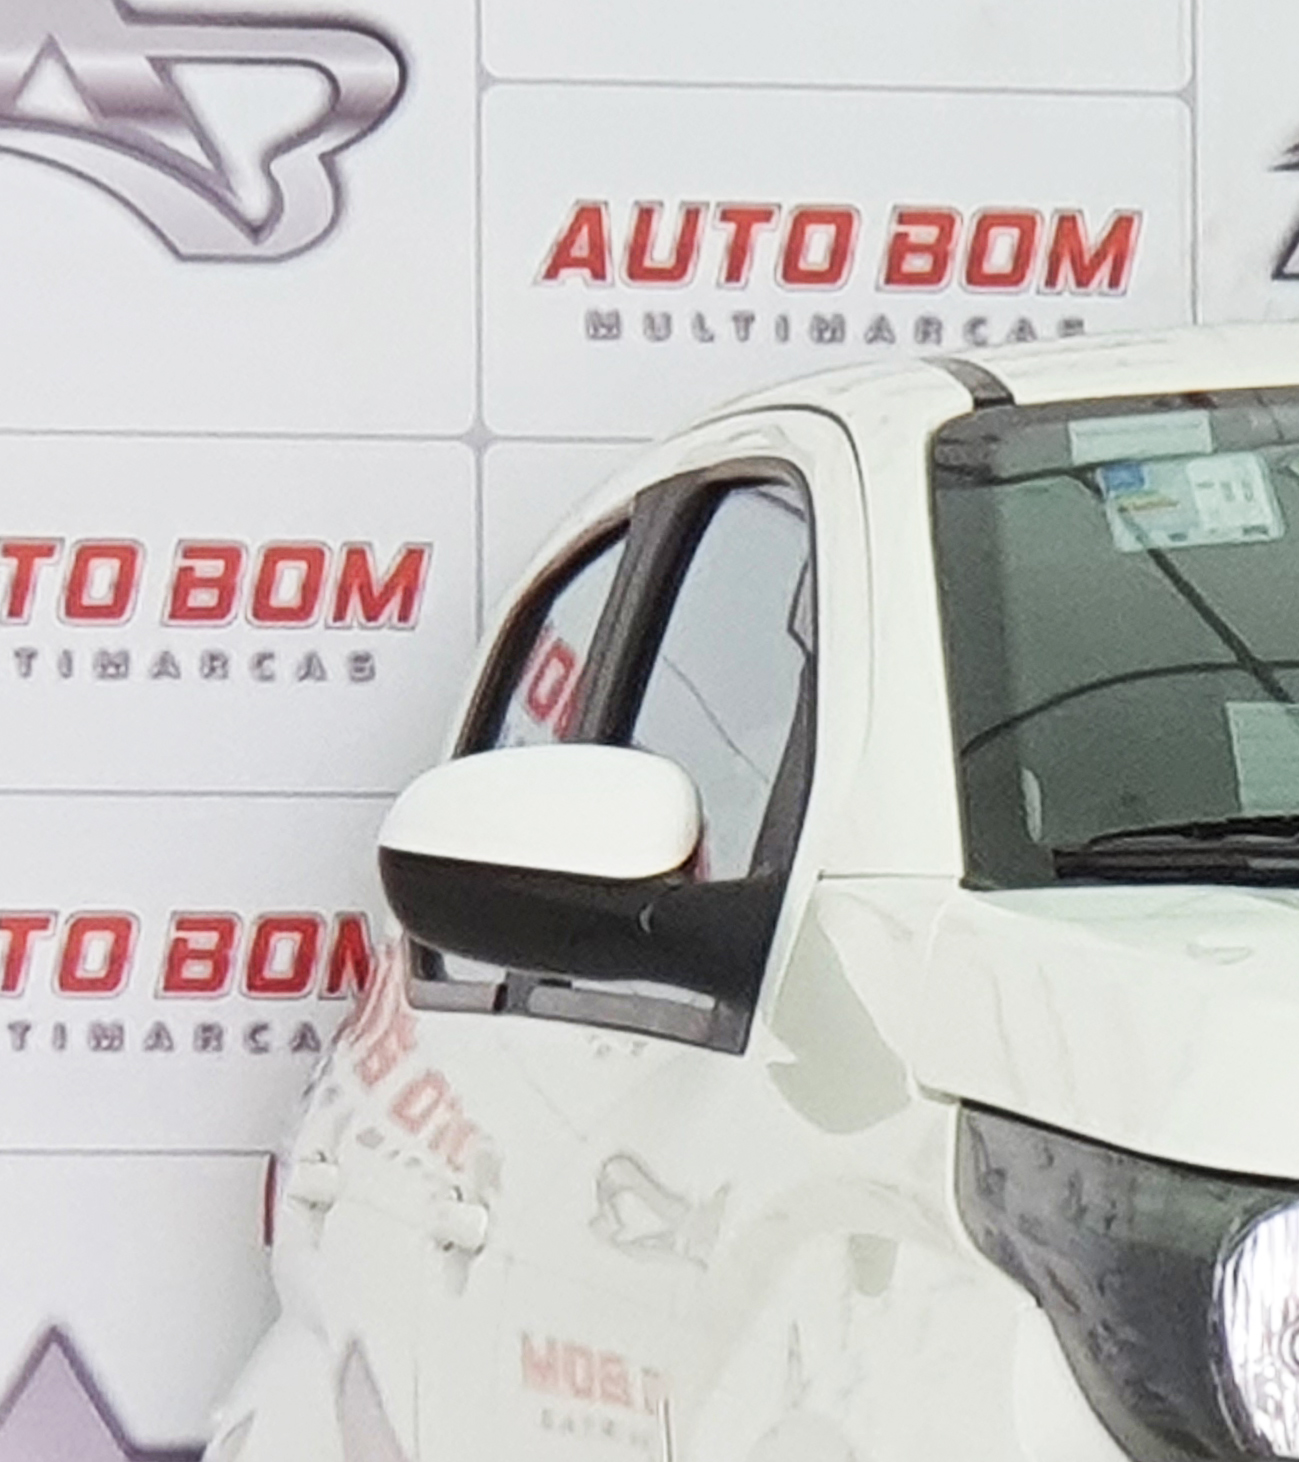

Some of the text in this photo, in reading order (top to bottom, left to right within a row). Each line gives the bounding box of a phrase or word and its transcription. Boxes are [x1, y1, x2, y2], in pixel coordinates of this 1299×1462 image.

[533, 199, 1143, 297] AUTO BOM
[161, 540, 433, 630] BOM
